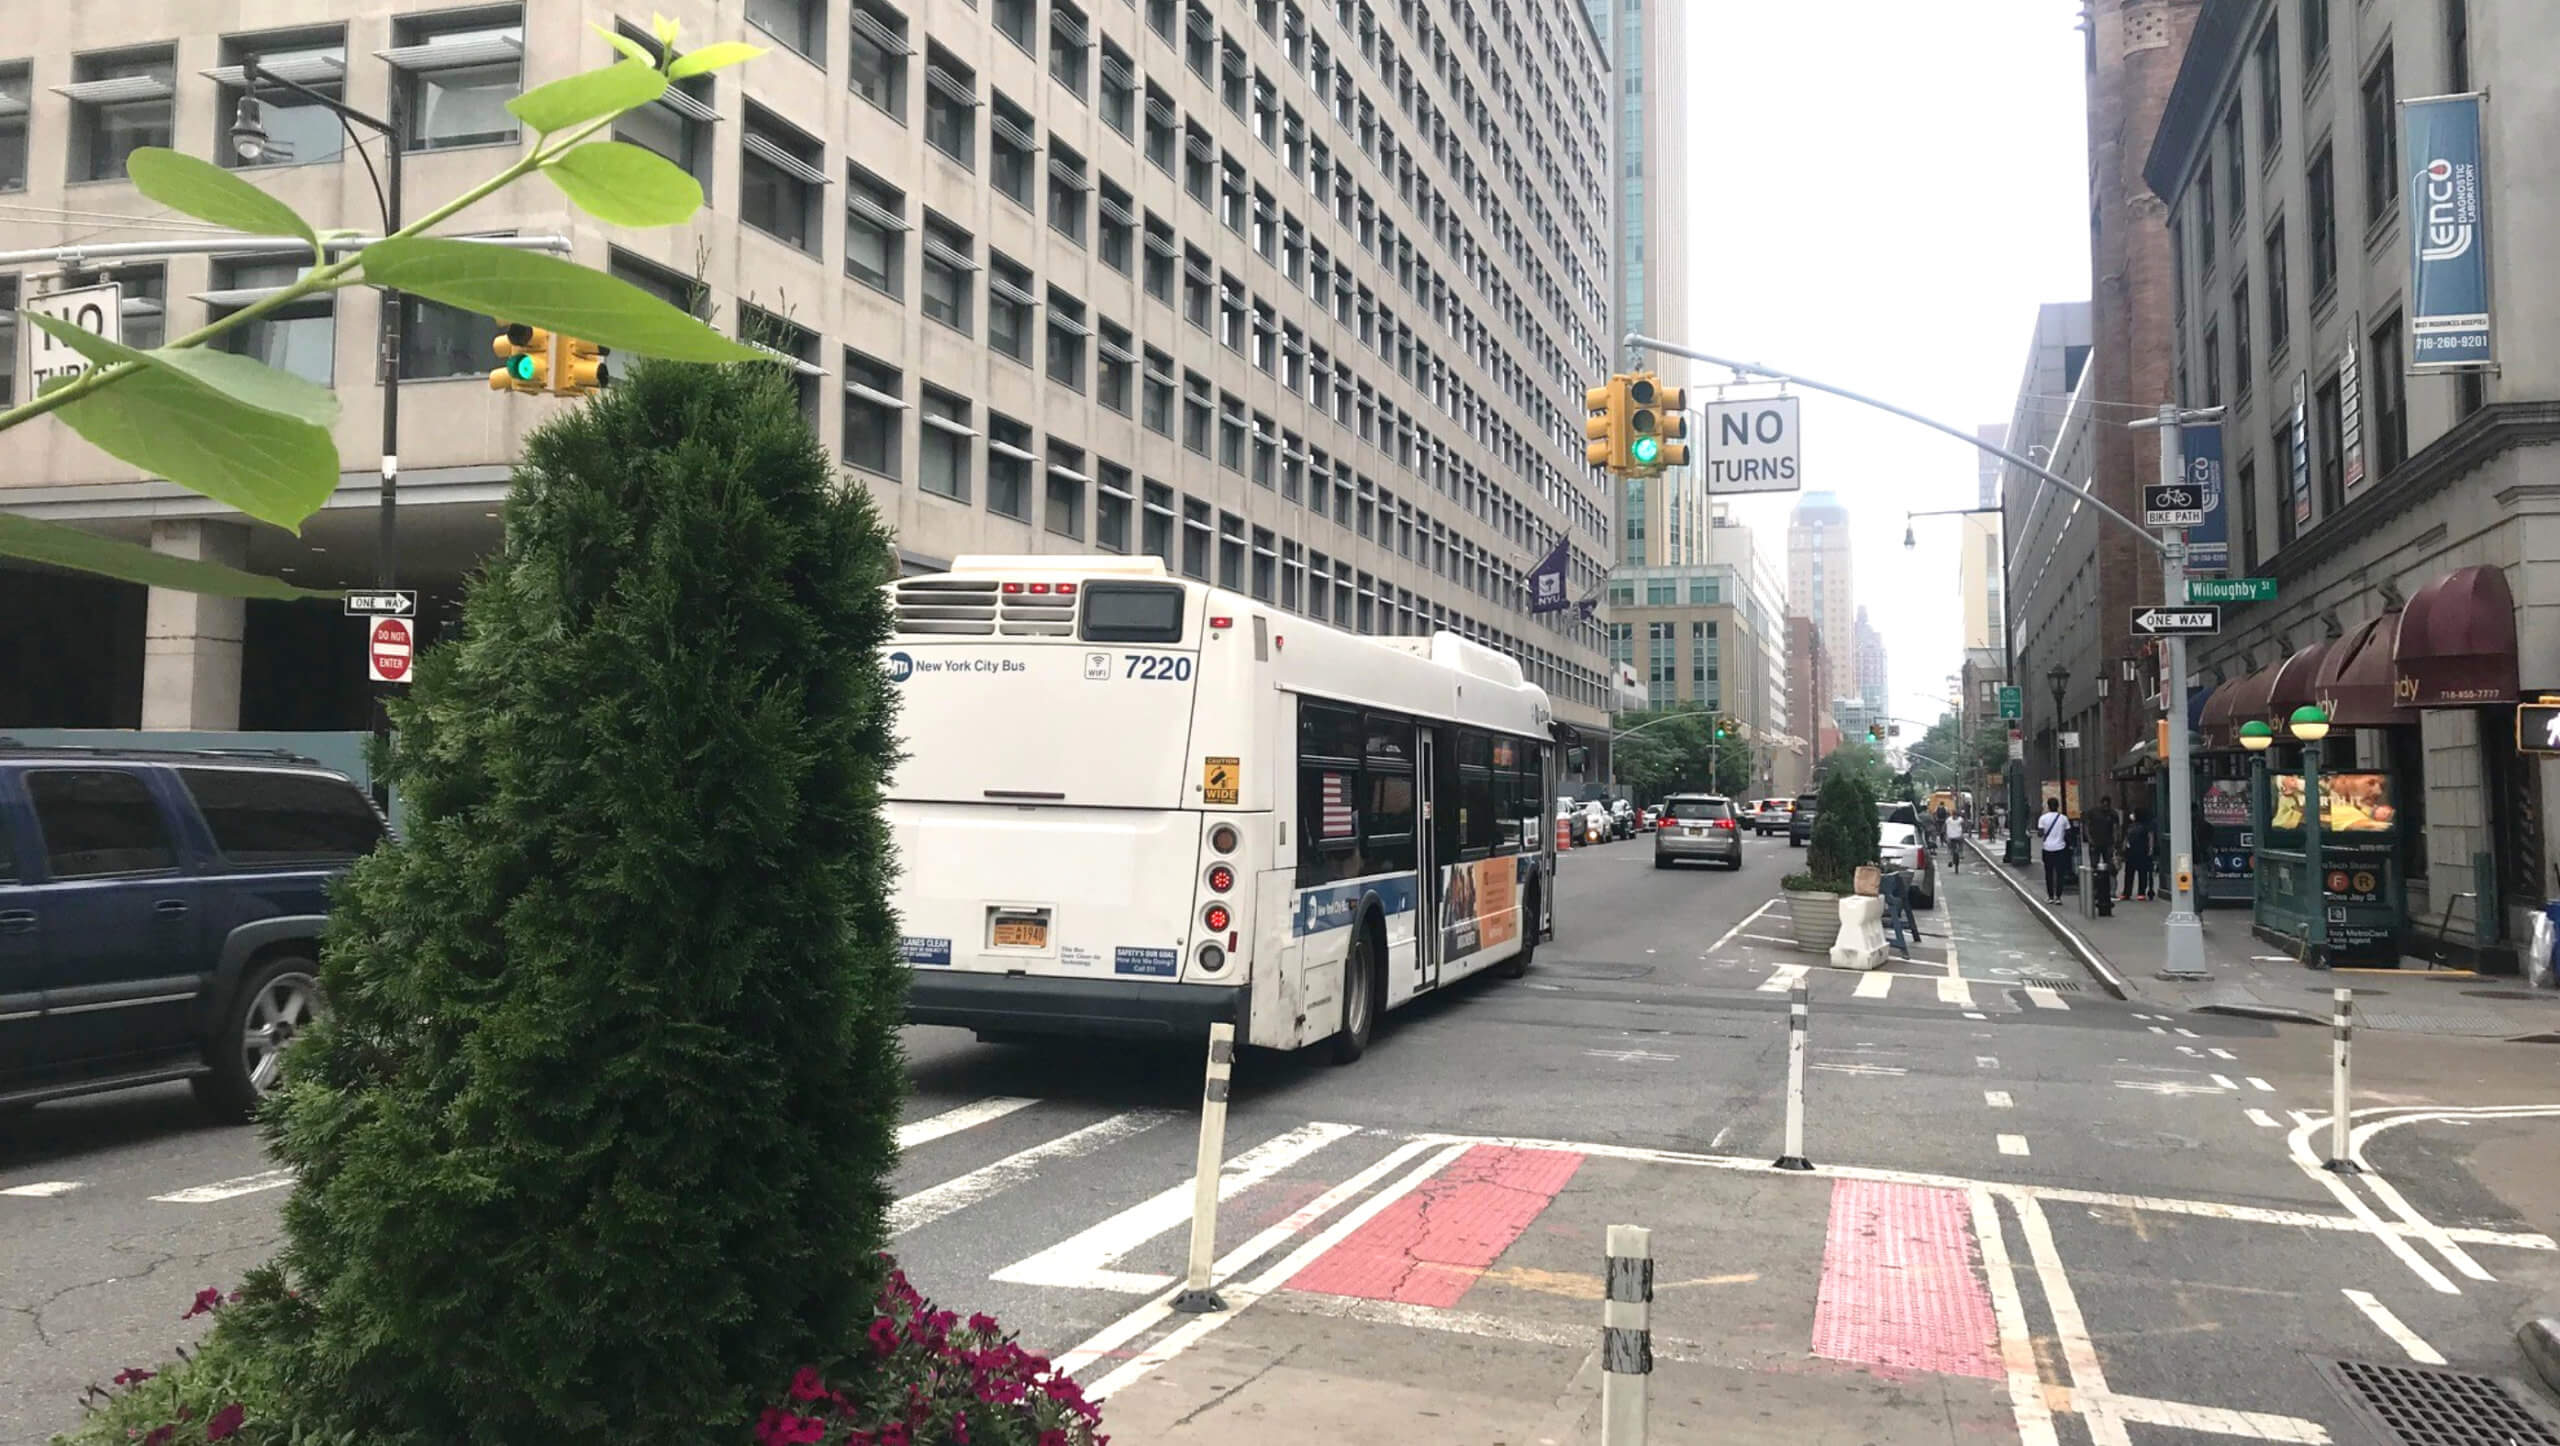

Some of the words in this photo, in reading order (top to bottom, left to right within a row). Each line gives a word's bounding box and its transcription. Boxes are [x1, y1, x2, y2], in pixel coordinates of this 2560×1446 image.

[2456, 163, 2467, 223] DIAGNOSTIC
[2466, 163, 2476, 223] LABORATORY
[2416, 335, 2487, 350] 718-260-9201
[1722, 410, 1783, 446] NO
[1711, 456, 1795, 482] TURNS
[2149, 511, 2171, 522] BIKE
[2175, 511, 2200, 522] PATH
[2192, 581, 2256, 600] Willoughby
[2261, 581, 2270, 590] St
[356, 598, 376, 608] ONE
[384, 599, 406, 608] WAY
[1538, 594, 1560, 605] NYU
[2147, 615, 2172, 626] ONE
[2179, 614, 2207, 625] WAY
[378, 630, 390, 641] DO
[391, 631, 406, 642] NOT
[379, 657, 404, 669] ENTER
[916, 660, 942, 671] New
[945, 660, 971, 671] York
[974, 659, 999, 673] City
[1002, 660, 1025, 671] Bus
[1124, 655, 1191, 681] 7220
[1206, 789, 1237, 799] WIDE
[2232, 857, 2242, 867] C
[2334, 875, 2342, 887] F
[2359, 875, 2370, 887] R
[903, 938, 925, 947] LANES
[926, 938, 949, 948] CLEAR
[1117, 948, 1145, 957] SAFETY'S
[1145, 949, 1158, 958] OUR
[1158, 950, 1175, 959] GOAL
